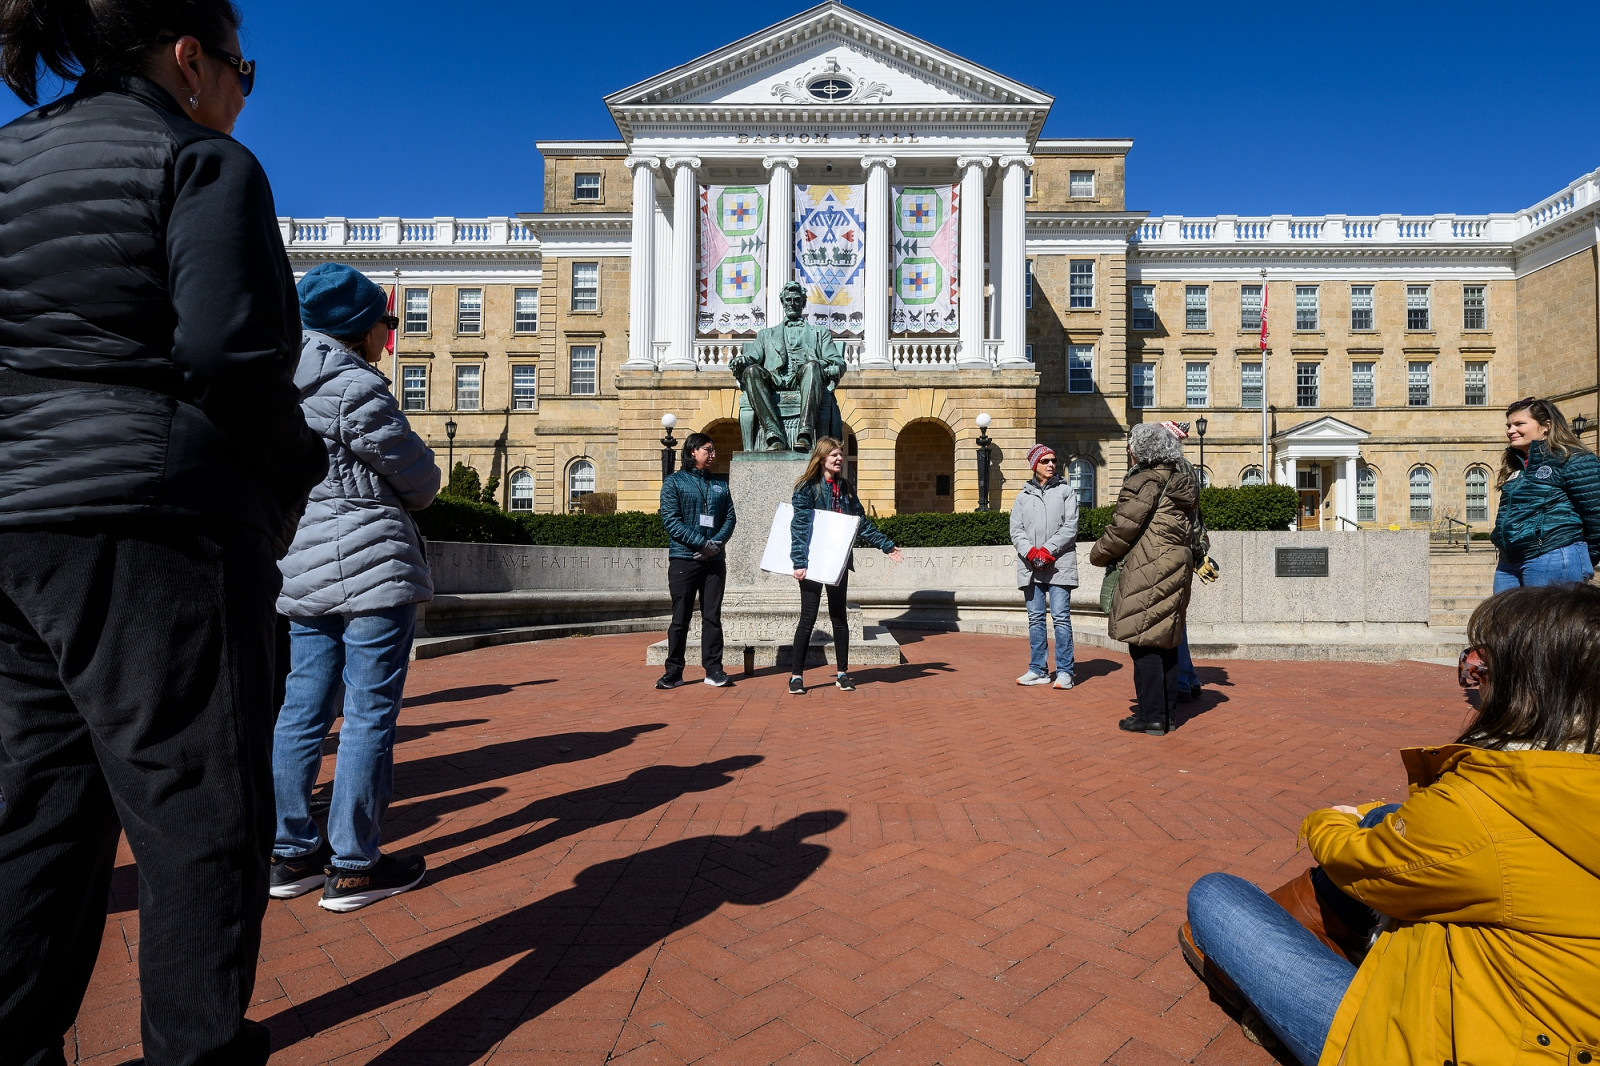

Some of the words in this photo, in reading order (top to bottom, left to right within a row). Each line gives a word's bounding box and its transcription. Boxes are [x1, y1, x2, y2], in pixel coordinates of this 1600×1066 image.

[737, 133, 830, 144] BASCOM
[857, 133, 920, 144] HALL
[452, 553, 473, 567] US
[486, 554, 530, 569] HAVE
[541, 555, 591, 569] FAITH
[601, 556, 643, 569] THAT
[853, 556, 875, 568] ND
[905, 556, 943, 568] THAT
[952, 555, 993, 568] FAITH
[694, 630, 769, 638] CECTICUT
[336, 876, 370, 889] HOKA
